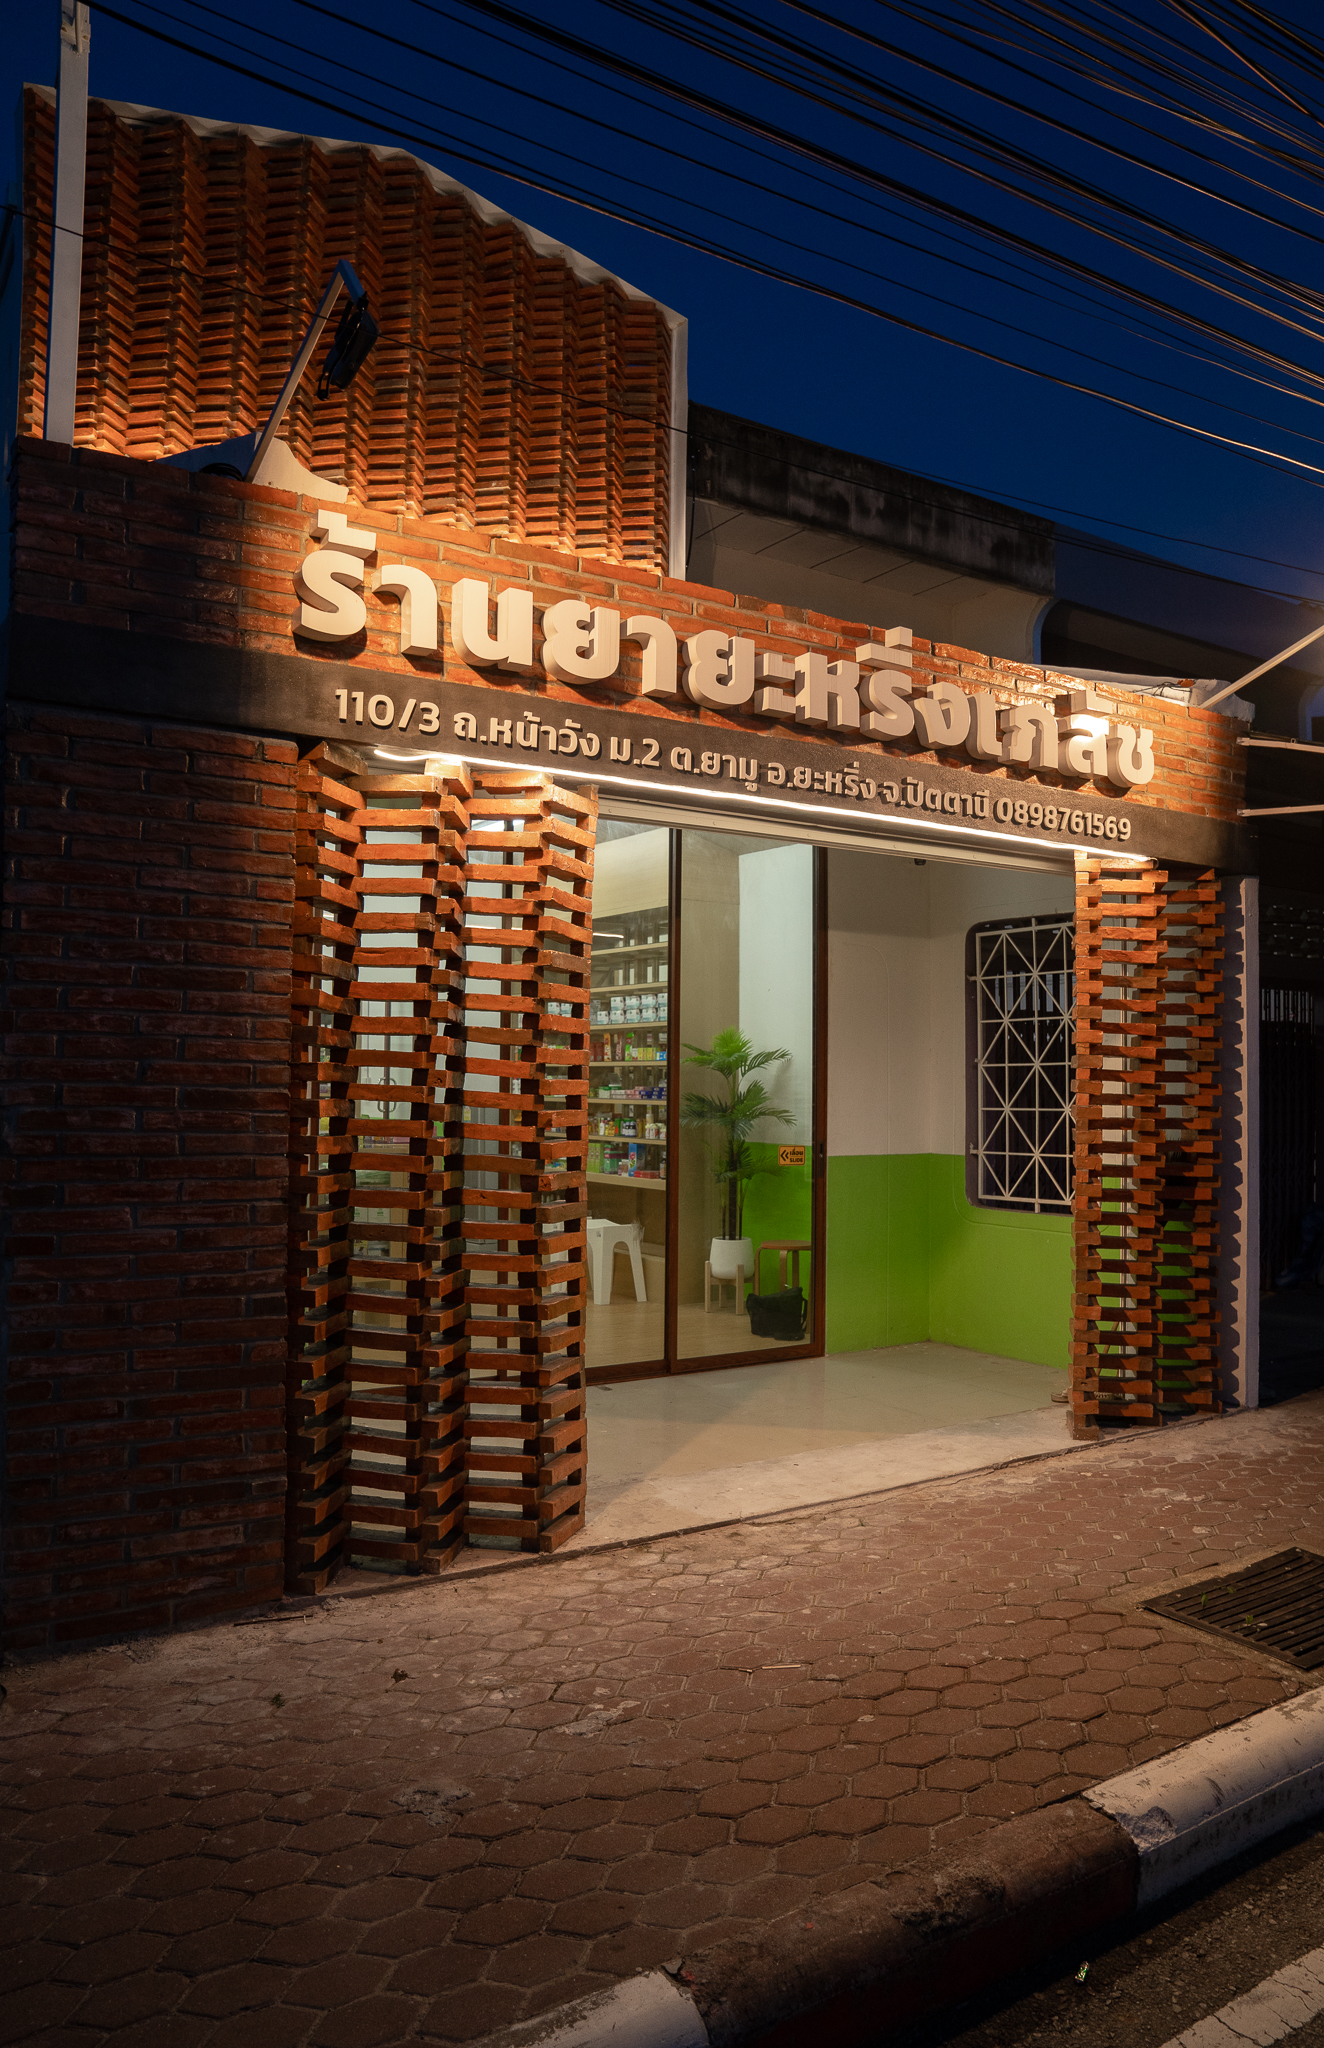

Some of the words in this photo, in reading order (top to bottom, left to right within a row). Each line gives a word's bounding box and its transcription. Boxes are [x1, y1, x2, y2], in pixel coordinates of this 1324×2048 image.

[292, 509, 1155, 788] ร้านยายะหริ่งเภสัช
[335, 689, 441, 733] 110/3
[453, 711, 600, 757] ถ.หน้าวัง
[609, 736, 661, 767] ม.2
[670, 746, 758, 791] ต.ยามู
[767, 761, 877, 799] อ.ยะหริ่ง
[882, 776, 989, 818] จ.ปัตตานี
[996, 798, 1131, 840] 0898761569
